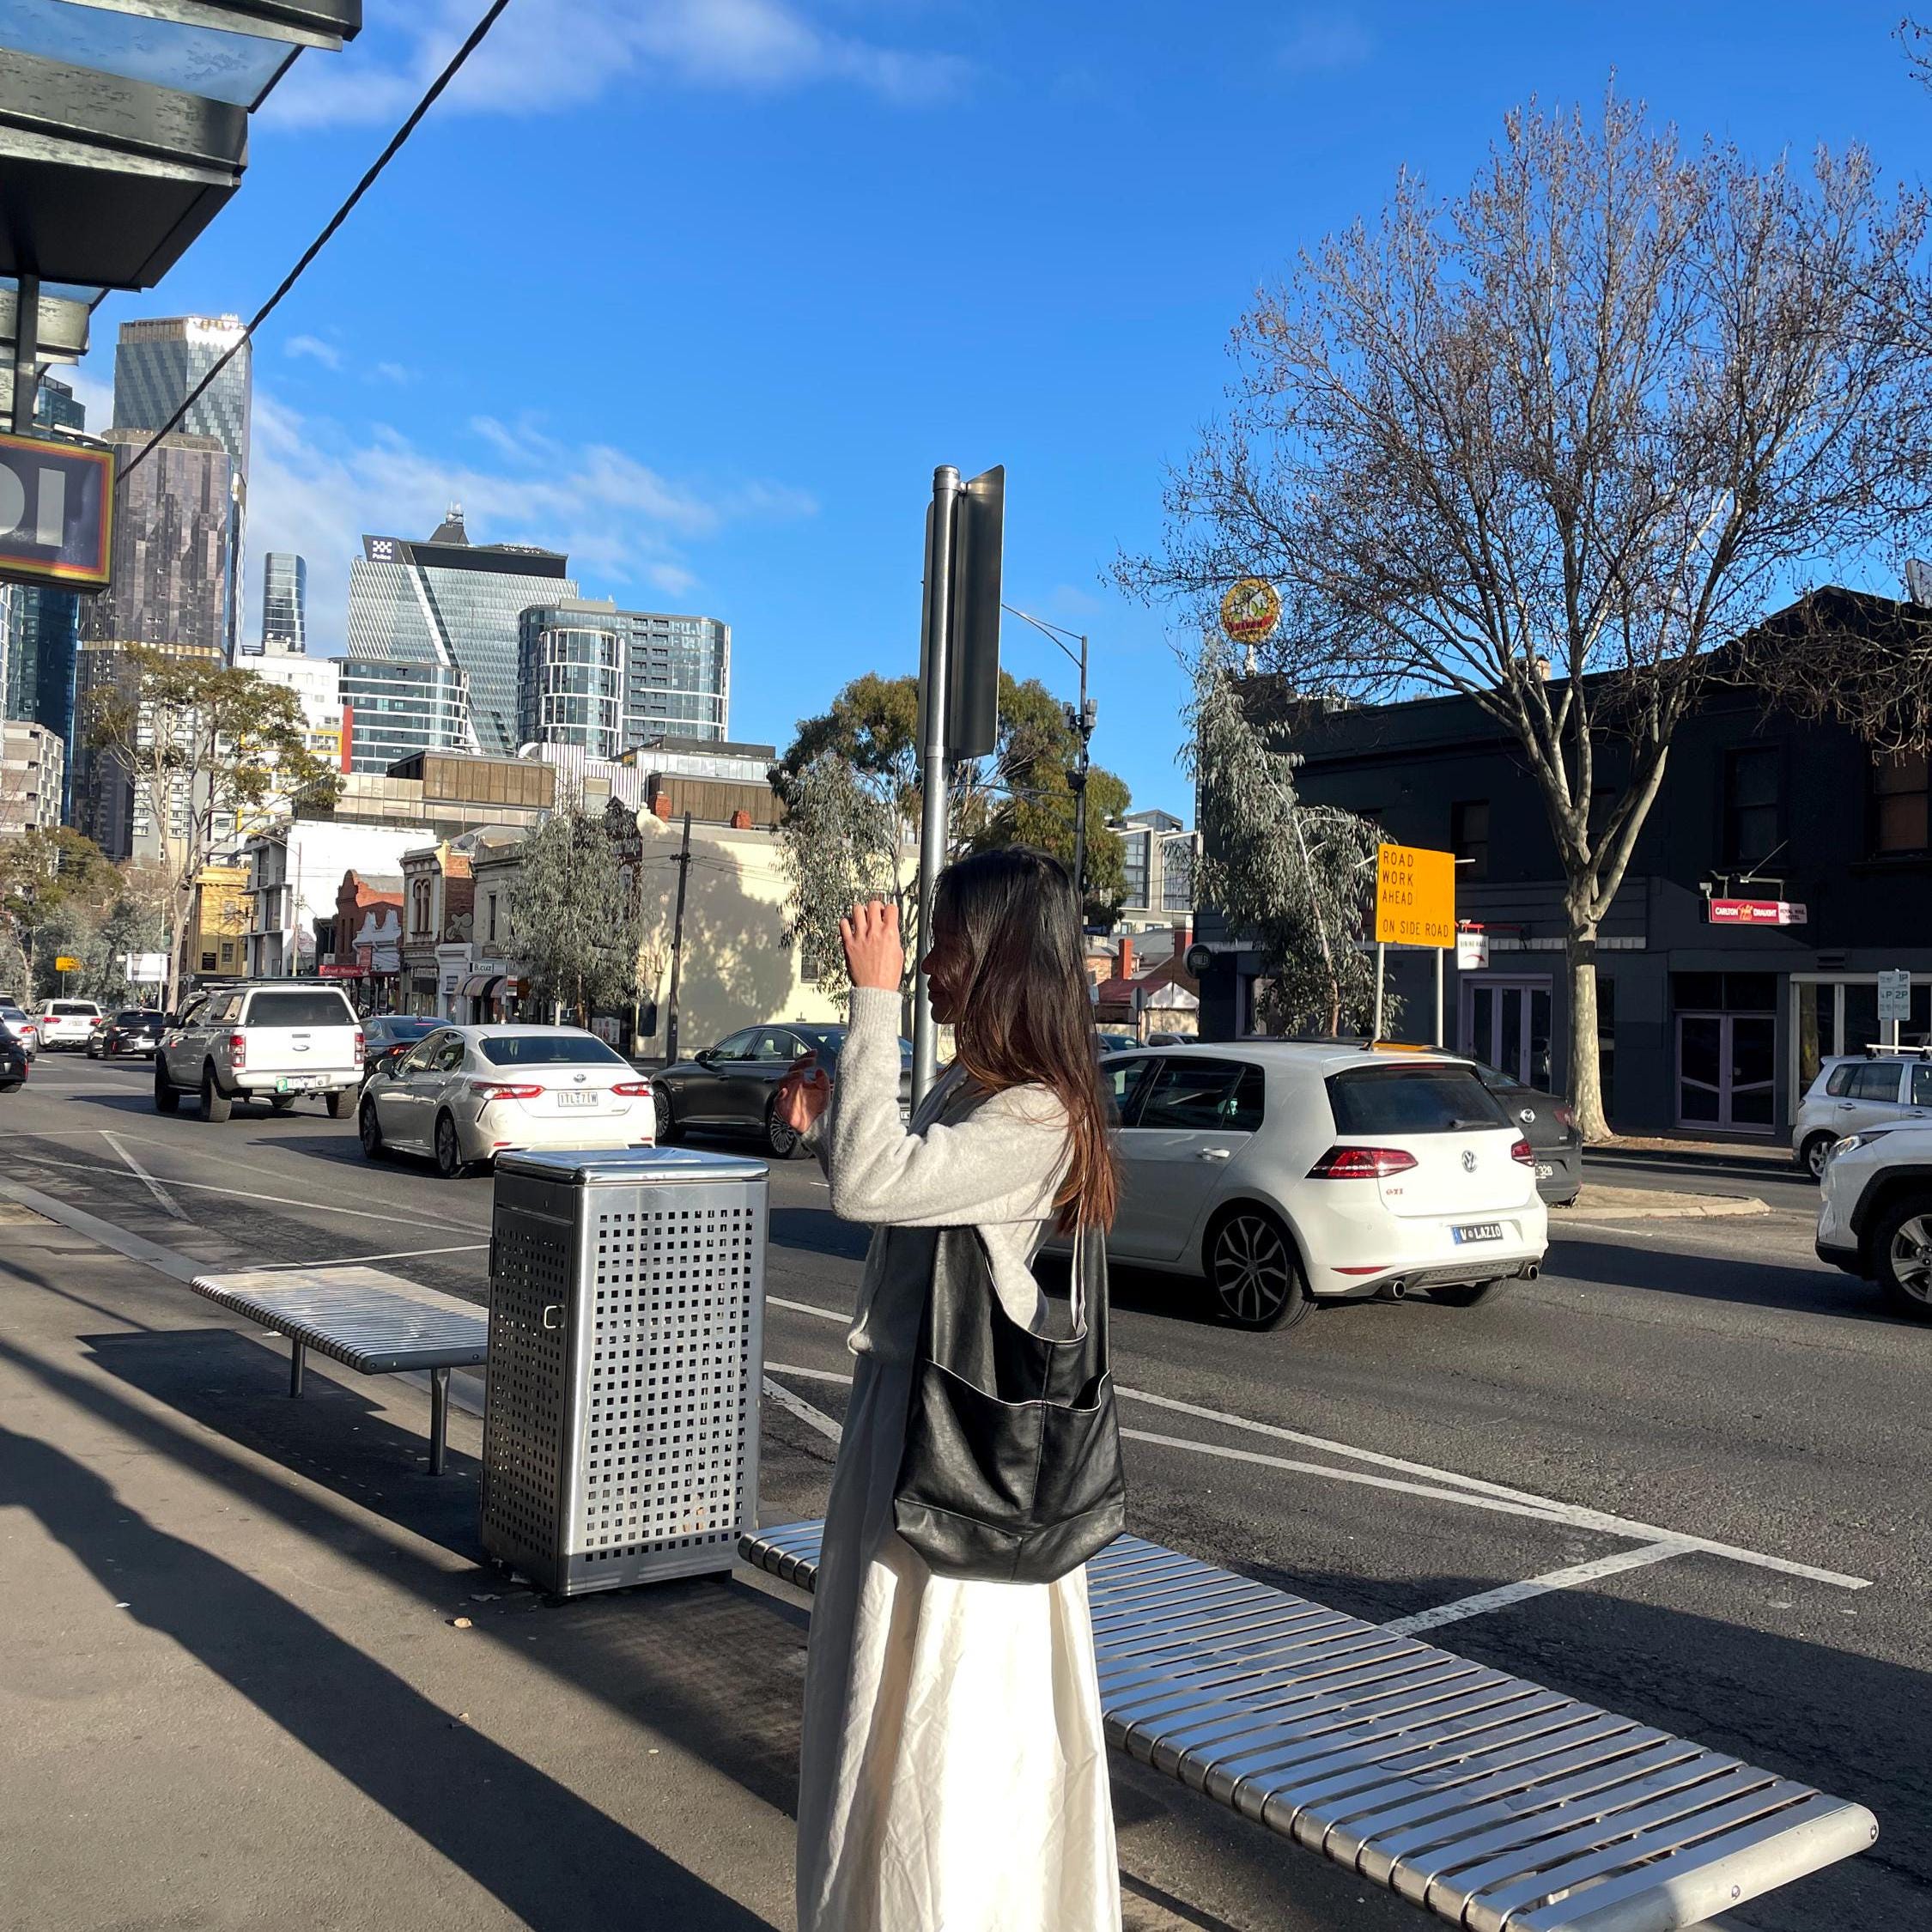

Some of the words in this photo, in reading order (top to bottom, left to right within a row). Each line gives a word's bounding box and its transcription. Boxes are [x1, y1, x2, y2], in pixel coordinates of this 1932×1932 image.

[1383, 851, 1414, 867] ROAD
[1382, 870, 1414, 887] WORK
[1382, 890, 1413, 906] AHEAD
[1715, 906, 1739, 916] CARLTON
[1753, 908, 1777, 917] DRAUGHT
[1382, 919, 1395, 933] ON
[1400, 920, 1421, 935] SIDE
[1425, 922, 1449, 939] ROAD
[474, 963, 492, 971] B.cuz
[1895, 990, 1909, 999] 2P
